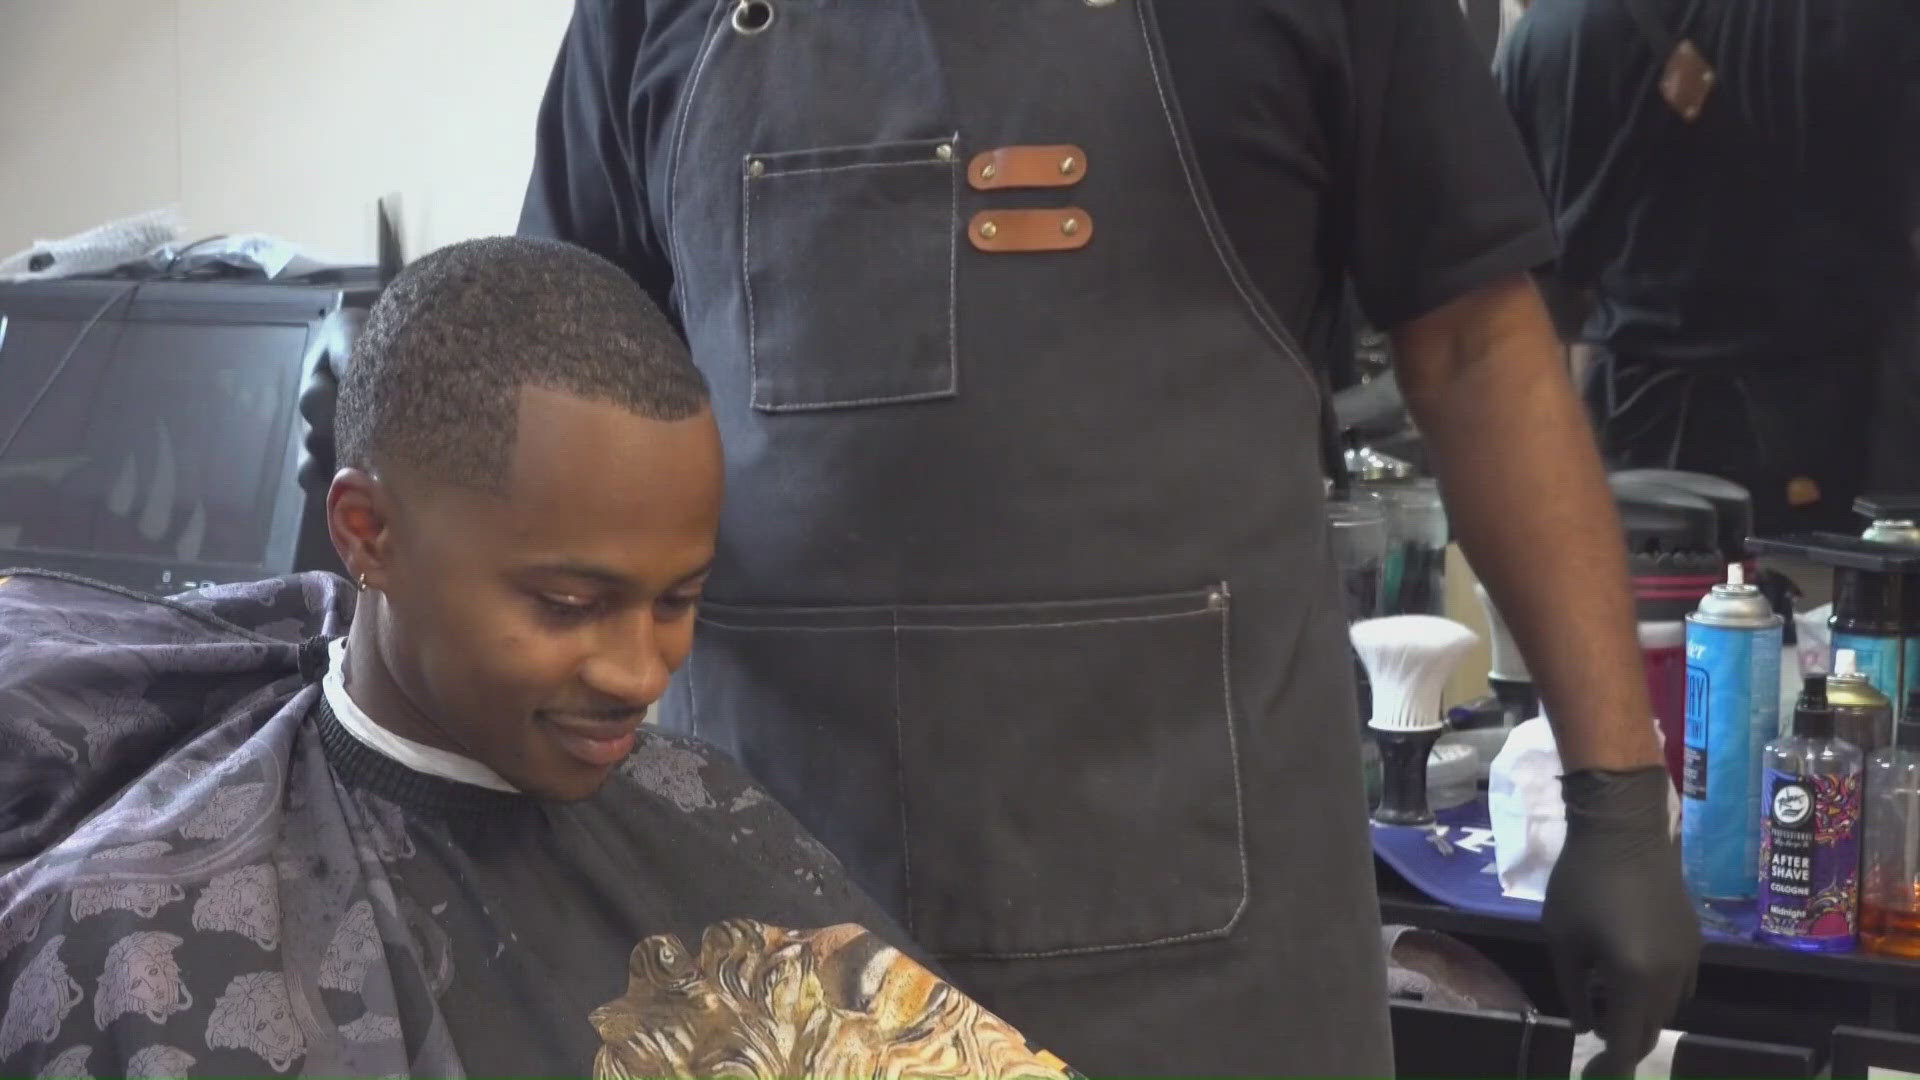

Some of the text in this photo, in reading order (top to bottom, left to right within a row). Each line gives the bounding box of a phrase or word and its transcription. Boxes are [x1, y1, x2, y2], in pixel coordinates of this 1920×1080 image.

[1771, 853, 1810, 868] AFTER
[1771, 865, 1810, 881] SHAVE
[1770, 882, 1810, 895] COLOGNE
[1770, 905, 1807, 919] Midnight
